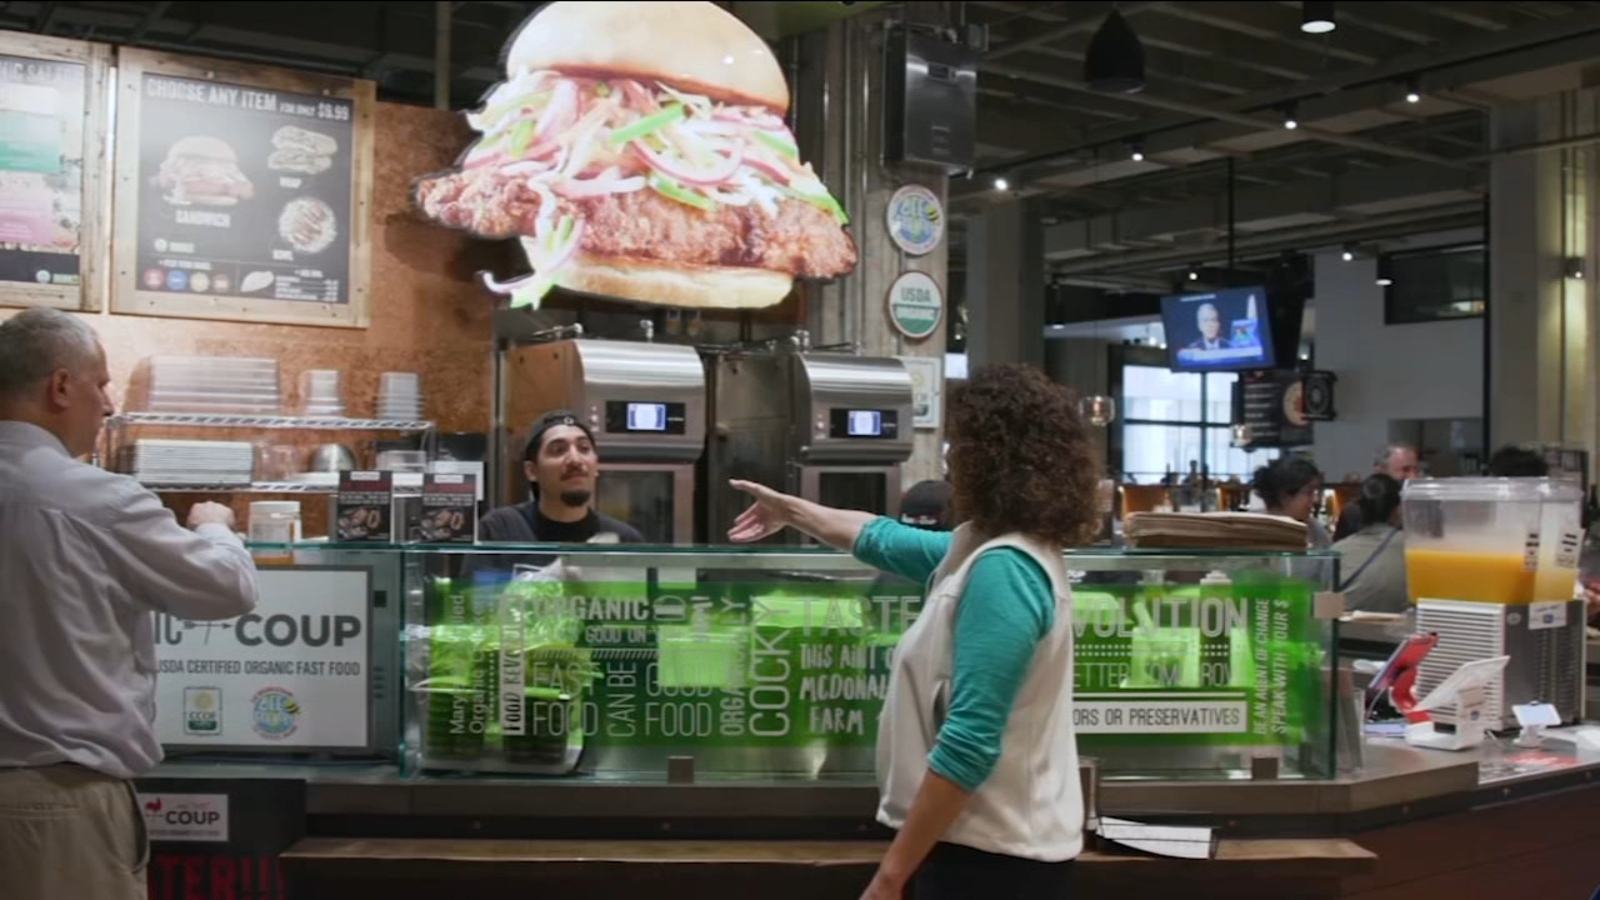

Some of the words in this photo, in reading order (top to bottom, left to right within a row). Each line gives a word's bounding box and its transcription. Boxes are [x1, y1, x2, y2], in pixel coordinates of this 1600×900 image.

[147, 78, 206, 102] CHOOSE
[208, 85, 239, 107] ANY
[241, 90, 277, 112] ITEM
[901, 287, 932, 302] USDA
[235, 614, 362, 647] COUP
[1255, 598, 1269, 645] CHANGE
[1273, 612, 1288, 645] OUR
[187, 660, 241, 675] CERTIFIED
[244, 660, 294, 675] ORGANIC
[296, 661, 325, 675] FAST
[329, 661, 360, 676] FOOD
[606, 662, 636, 687] BE
[750, 596, 790, 736] COCKY
[1272, 651, 1287, 687] WITH
[503, 691, 521, 731] FOOD
[534, 702, 598, 736] FOOD
[606, 694, 636, 737] CAN
[646, 702, 712, 736] FOOD
[810, 706, 864, 736] FARM
[1105, 708, 1122, 726] OR
[1129, 708, 1240, 726] PRESERVATIVES
[1271, 691, 1287, 734] SPEAK
[165, 811, 220, 825] COUP
